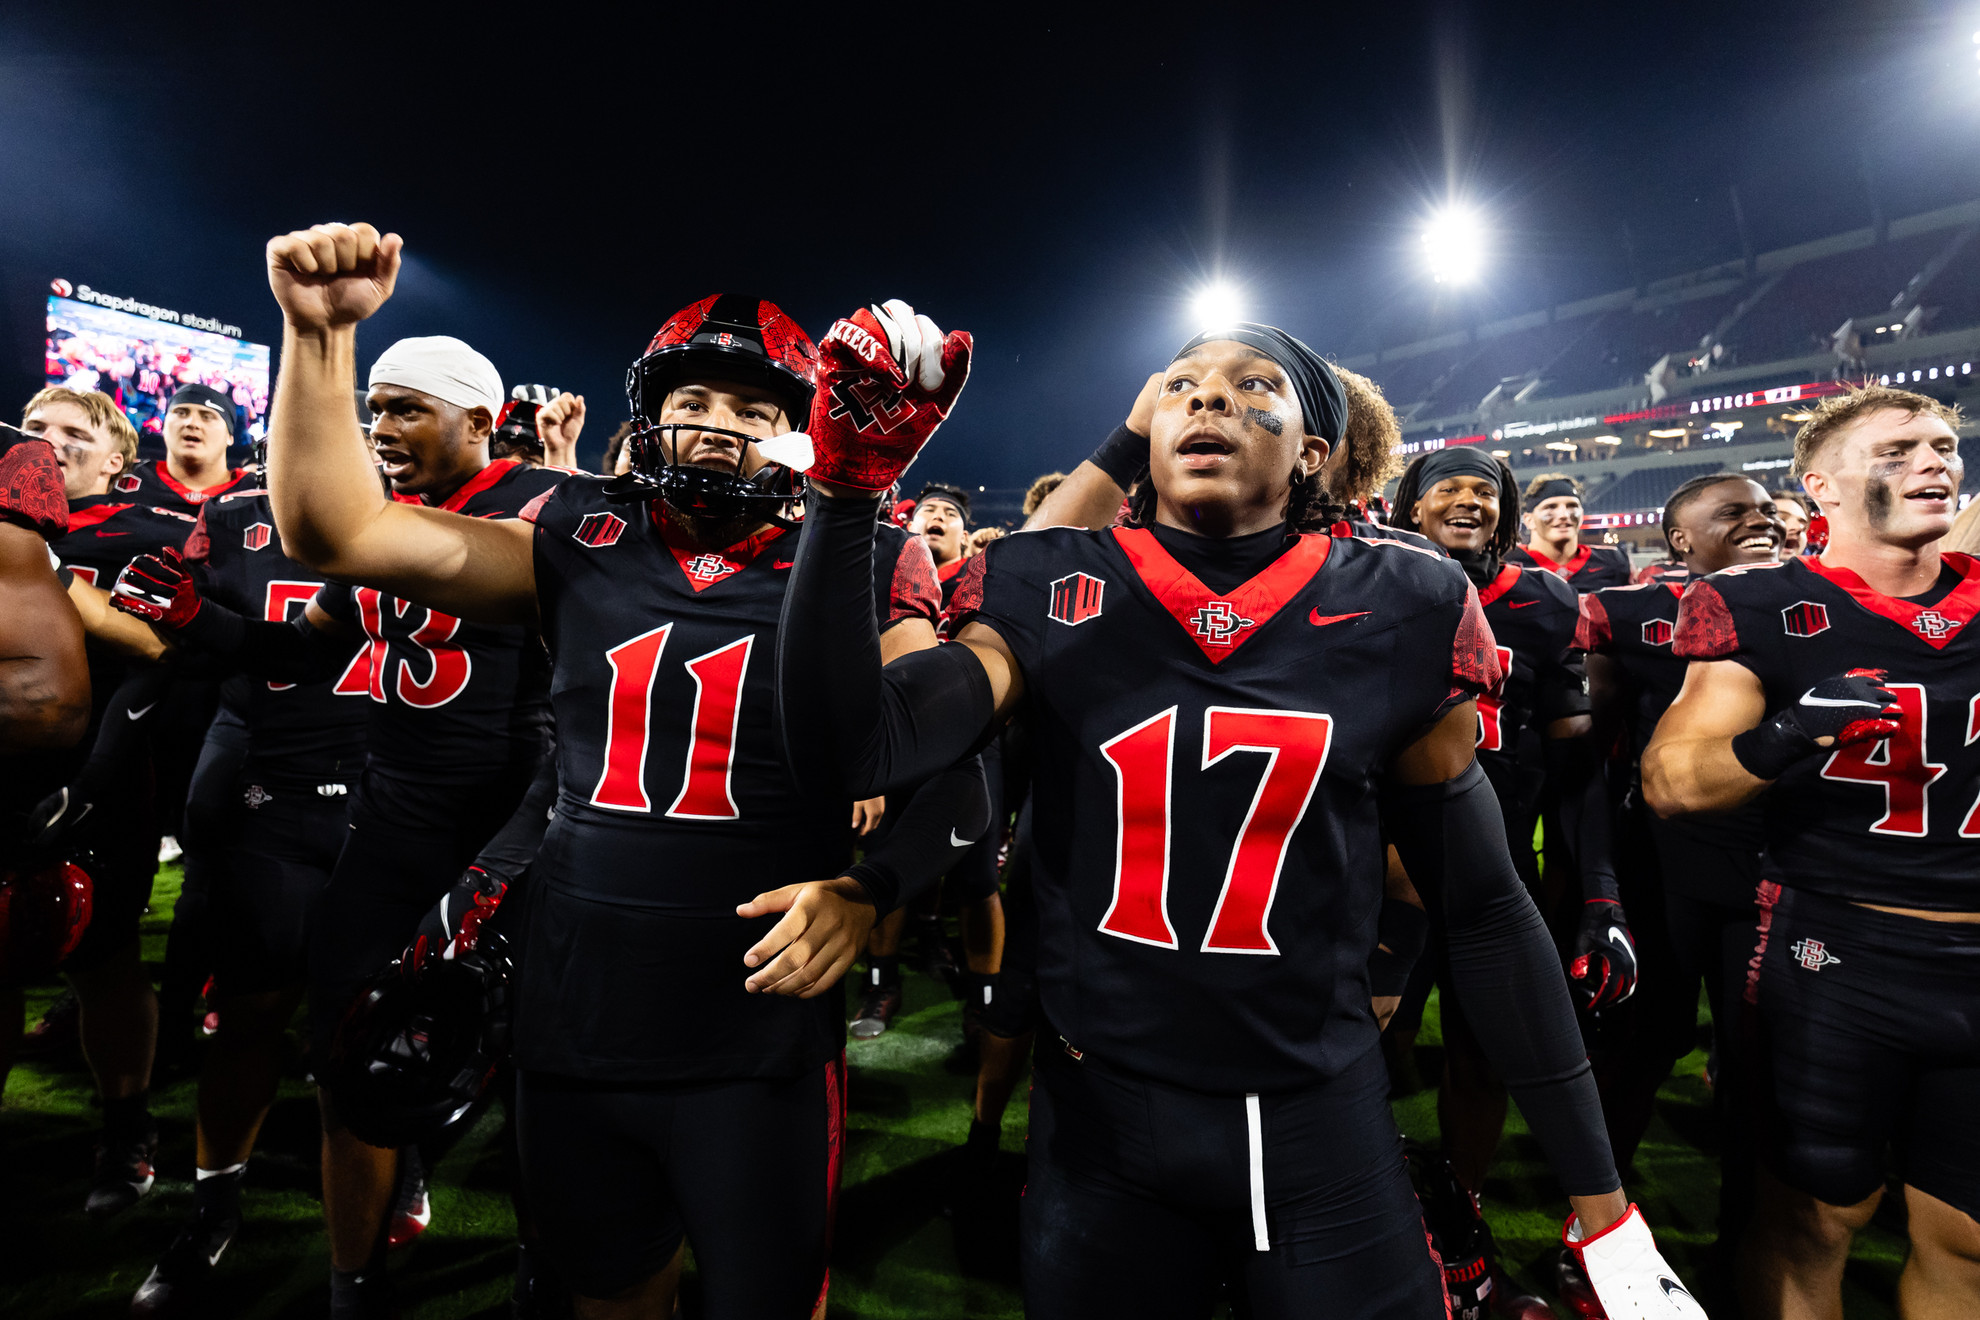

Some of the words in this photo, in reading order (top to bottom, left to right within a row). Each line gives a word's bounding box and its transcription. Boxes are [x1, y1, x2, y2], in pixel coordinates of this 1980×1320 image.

[76, 284, 179, 323] Snapdragon
[181, 313, 242, 338] stadium
[828, 320, 883, 362] AZTECS
[1690, 392, 1753, 414] AZTECS
[1764, 385, 1801, 404] WIN
[590, 622, 755, 820] 11
[1819, 682, 1980, 838] 4
[1097, 705, 1334, 956] 17
